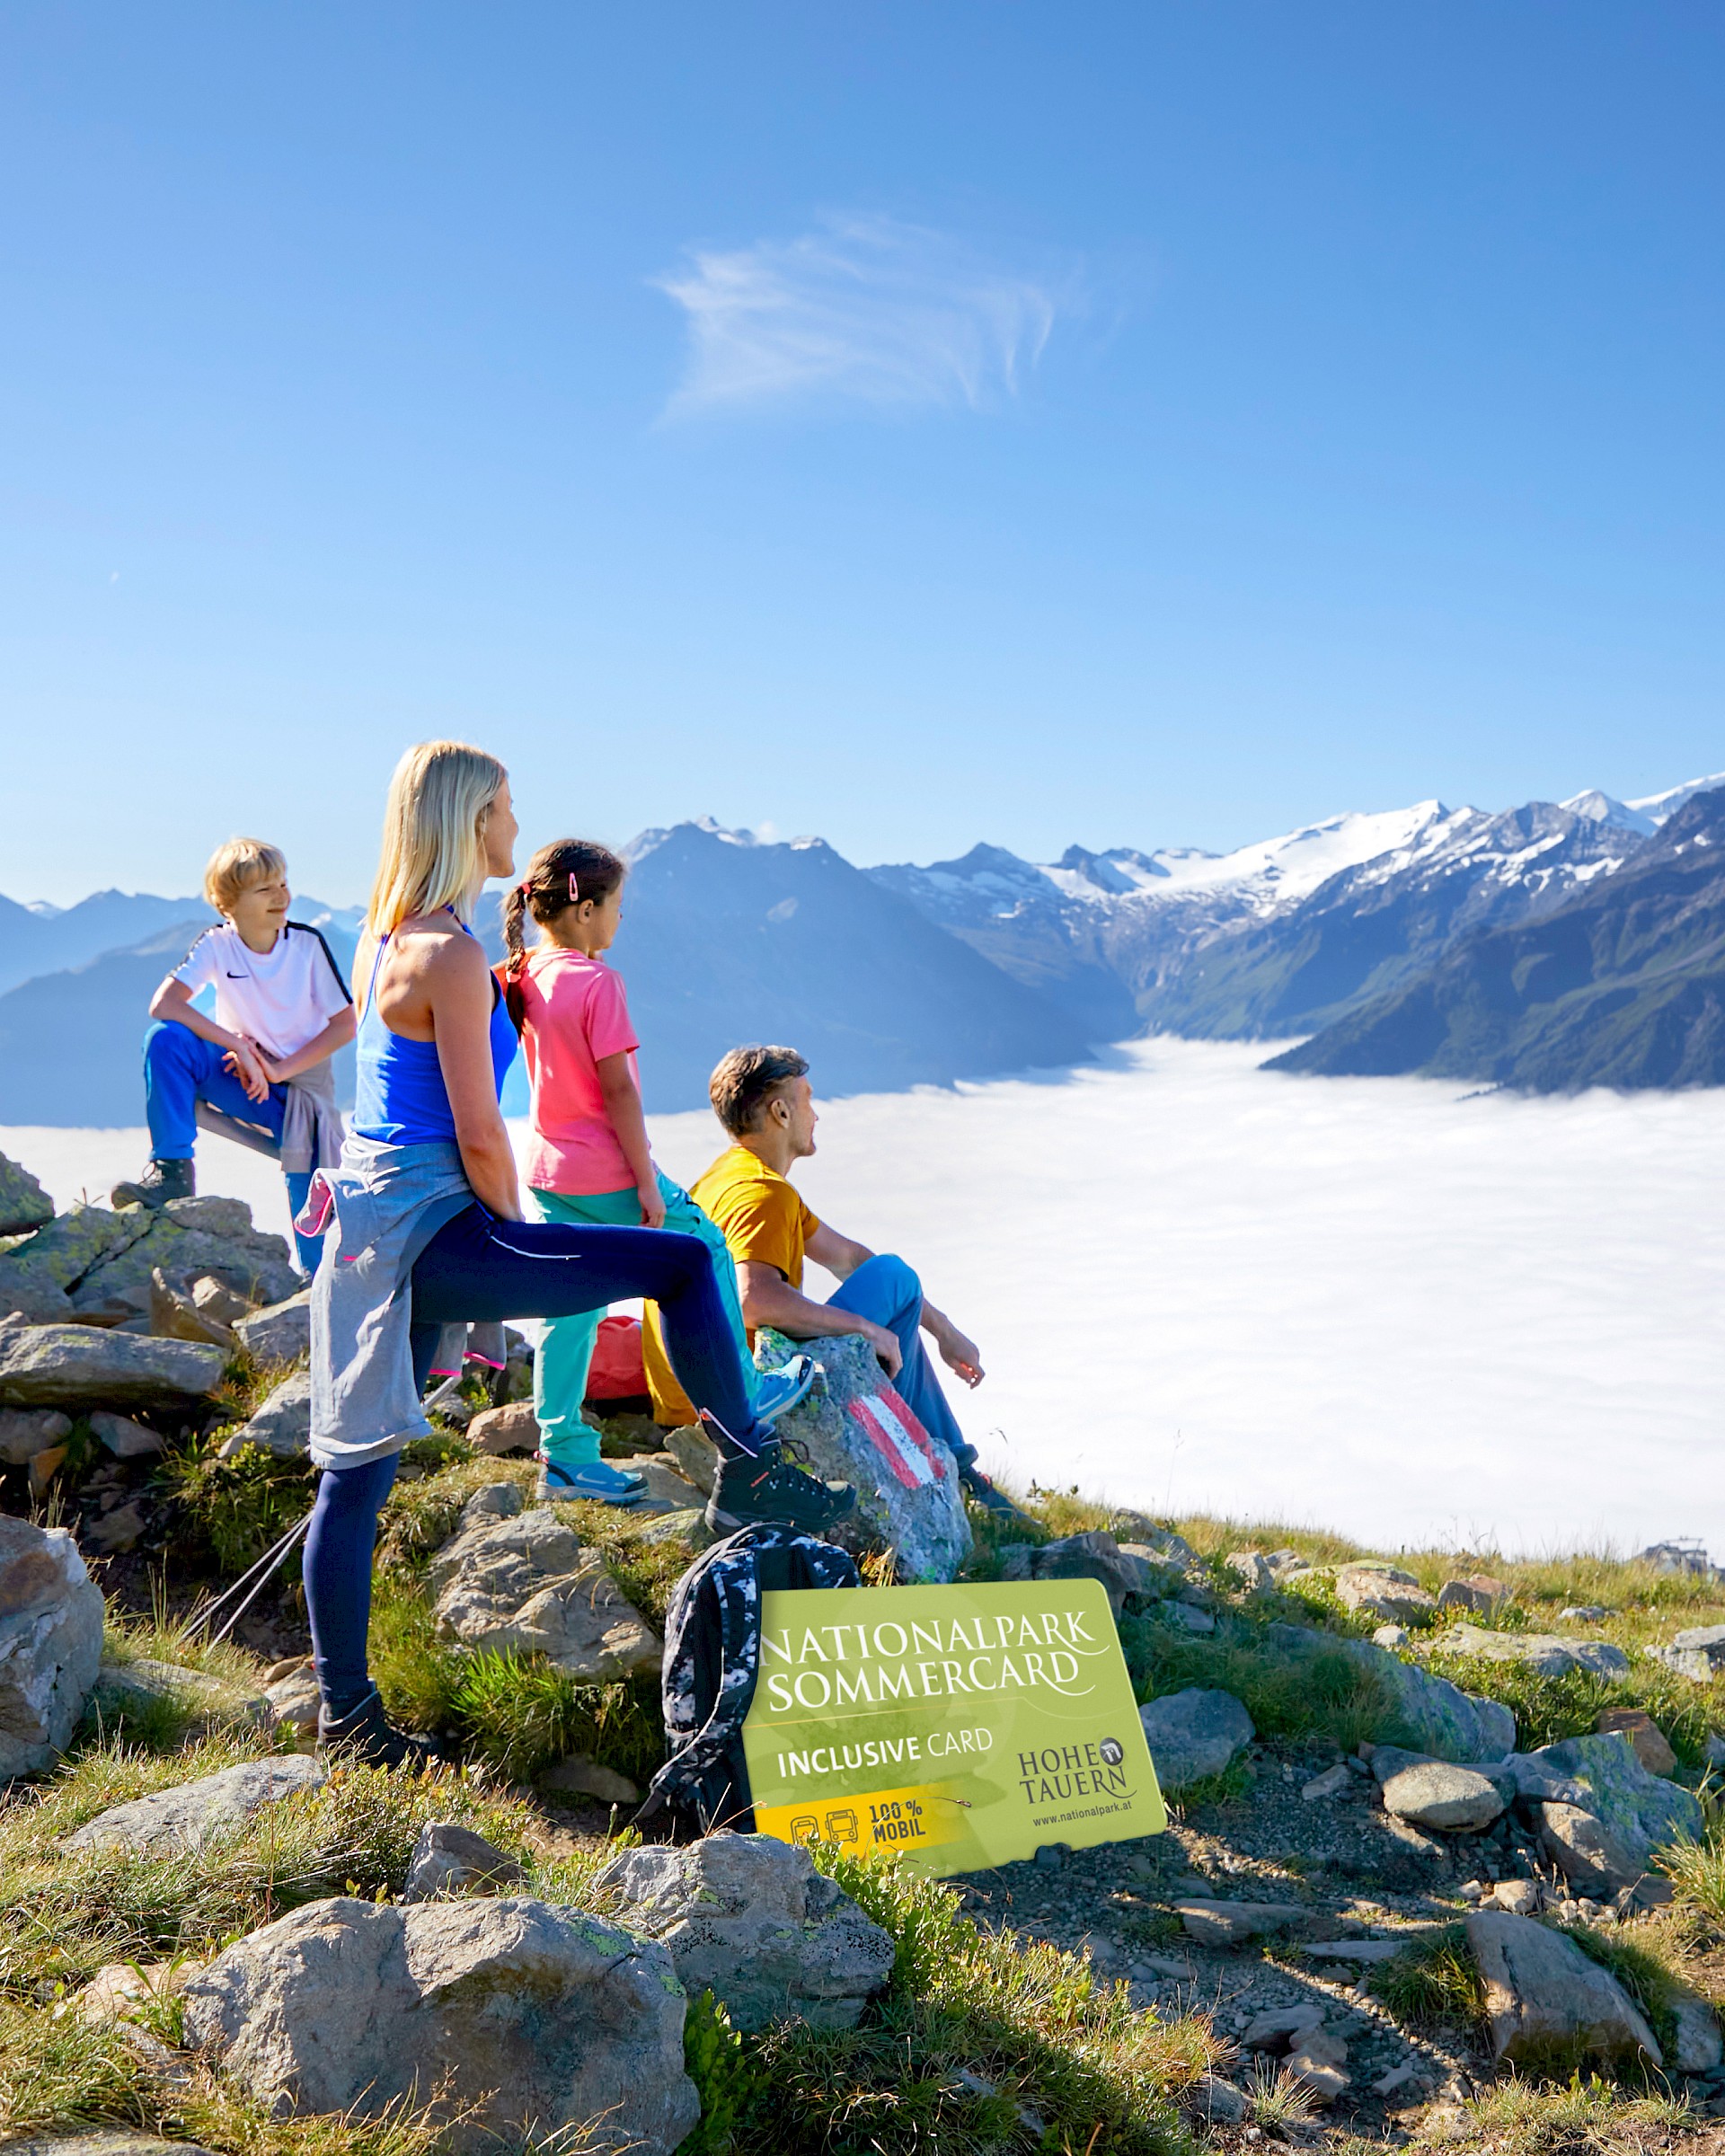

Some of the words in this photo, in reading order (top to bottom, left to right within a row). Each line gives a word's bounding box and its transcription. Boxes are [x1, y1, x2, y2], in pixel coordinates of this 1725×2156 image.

[759, 1611, 1110, 1666] NATIONALPARK
[767, 1651, 1096, 1711] SOMMERCARD
[778, 1736, 922, 1779] INCLUSIVE
[927, 1727, 994, 1757] CARD
[1017, 1743, 1101, 1777] HOHE
[1019, 1765, 1137, 1805] TAUERN
[869, 1801, 901, 1824] 100
[907, 1799, 923, 1816] %
[1032, 1800, 1132, 1827] www.nationalpark.at
[872, 1818, 925, 1843] MOBIL
